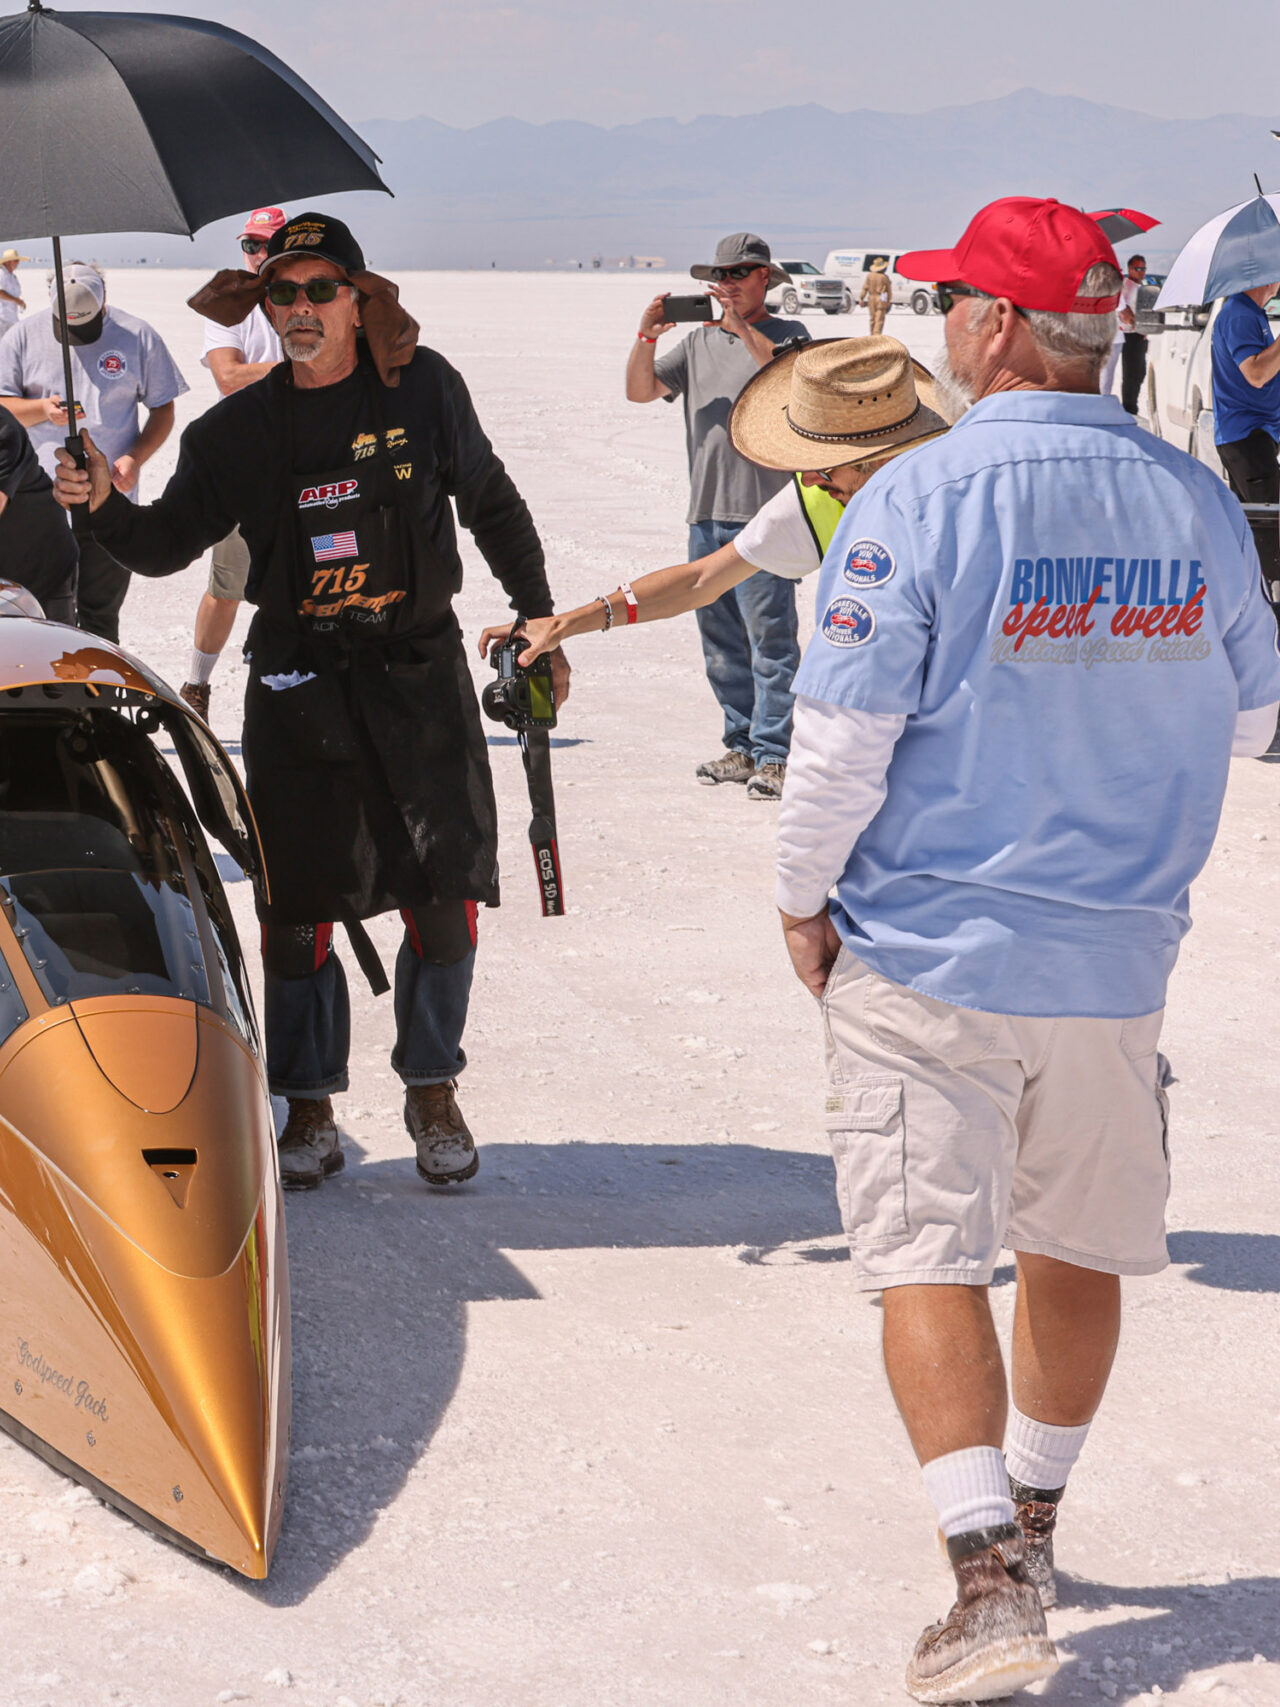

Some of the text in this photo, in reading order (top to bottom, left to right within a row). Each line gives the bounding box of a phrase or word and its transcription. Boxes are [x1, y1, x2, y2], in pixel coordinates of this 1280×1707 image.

[353, 445, 376, 461] 715
[298, 479, 358, 504] ARP
[312, 563, 370, 596] 715
[1010, 557, 1205, 607] BONNEVILLE
[350, 611, 387, 624] TEAM
[1111, 584, 1208, 638] week
[538, 849, 555, 881] EOS
[17, 1336, 74, 1396] Godspeed
